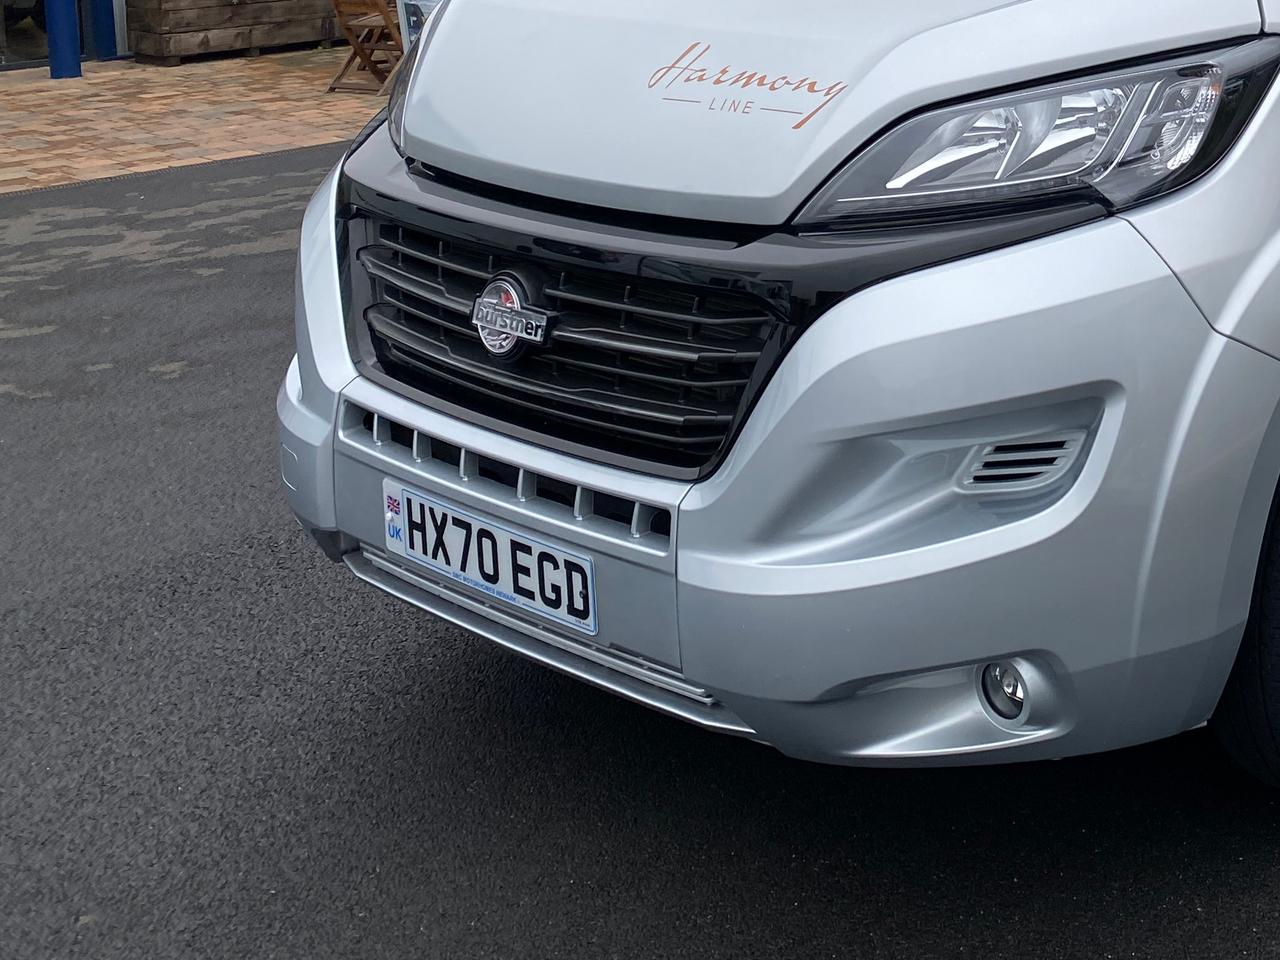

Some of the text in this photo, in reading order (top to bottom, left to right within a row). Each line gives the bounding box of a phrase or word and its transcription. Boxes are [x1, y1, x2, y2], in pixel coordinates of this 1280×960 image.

[648, 41, 849, 130] Harmony
[708, 97, 755, 115] LINE
[387, 523, 403, 543] UK
[406, 497, 591, 621] HX70 EGD
